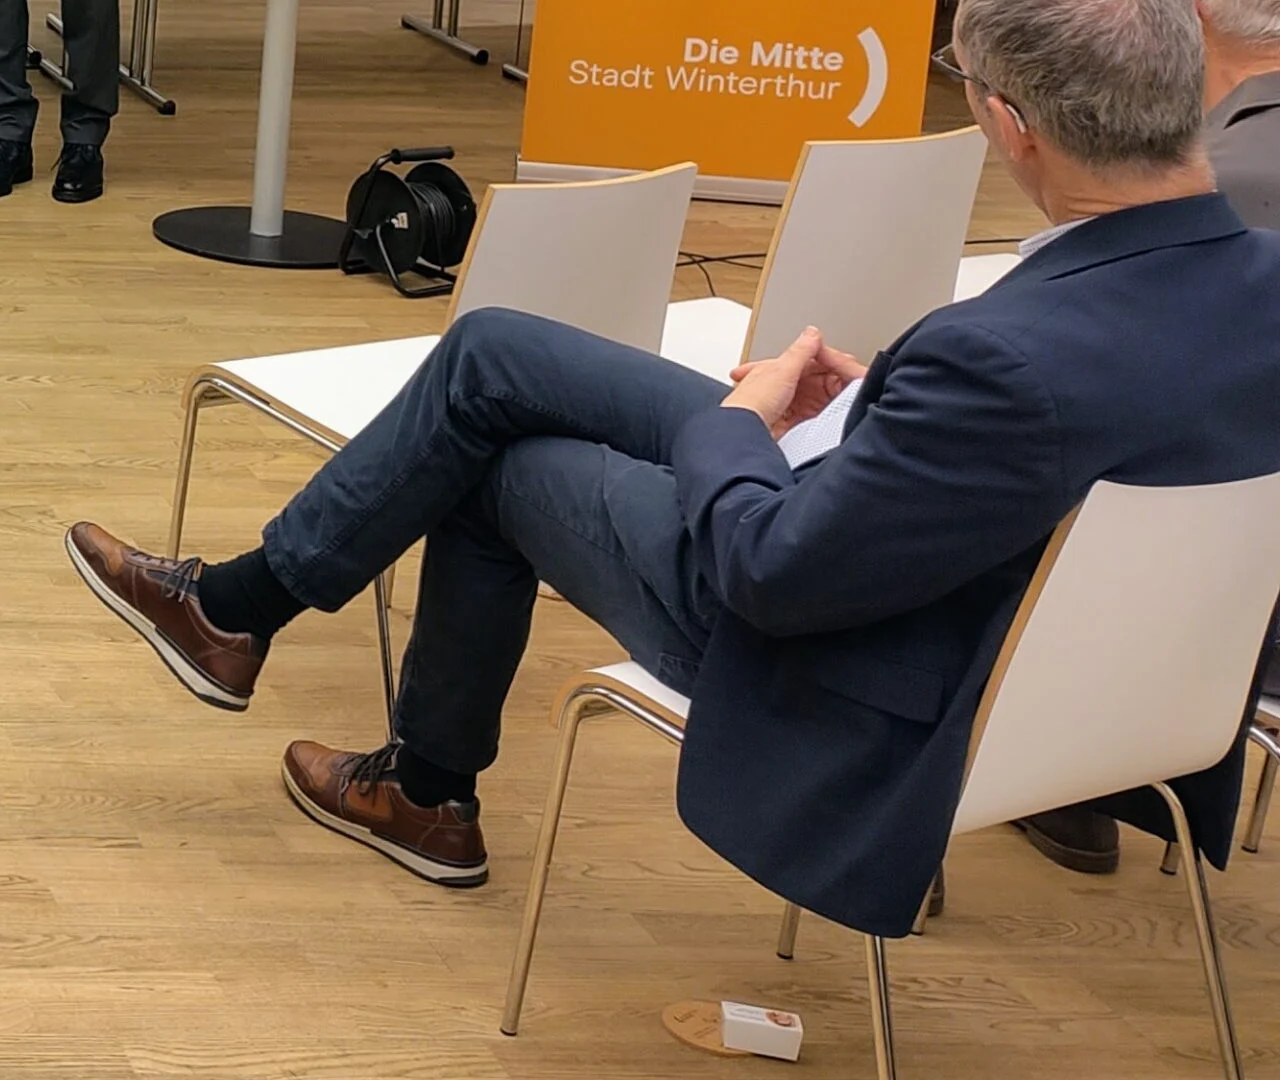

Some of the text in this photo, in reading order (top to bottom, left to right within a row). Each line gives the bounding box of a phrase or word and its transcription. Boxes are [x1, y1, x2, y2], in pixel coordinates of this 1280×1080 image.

[683, 37, 844, 71] Die Mitte
[568, 59, 842, 101] Stadt Winterthur
